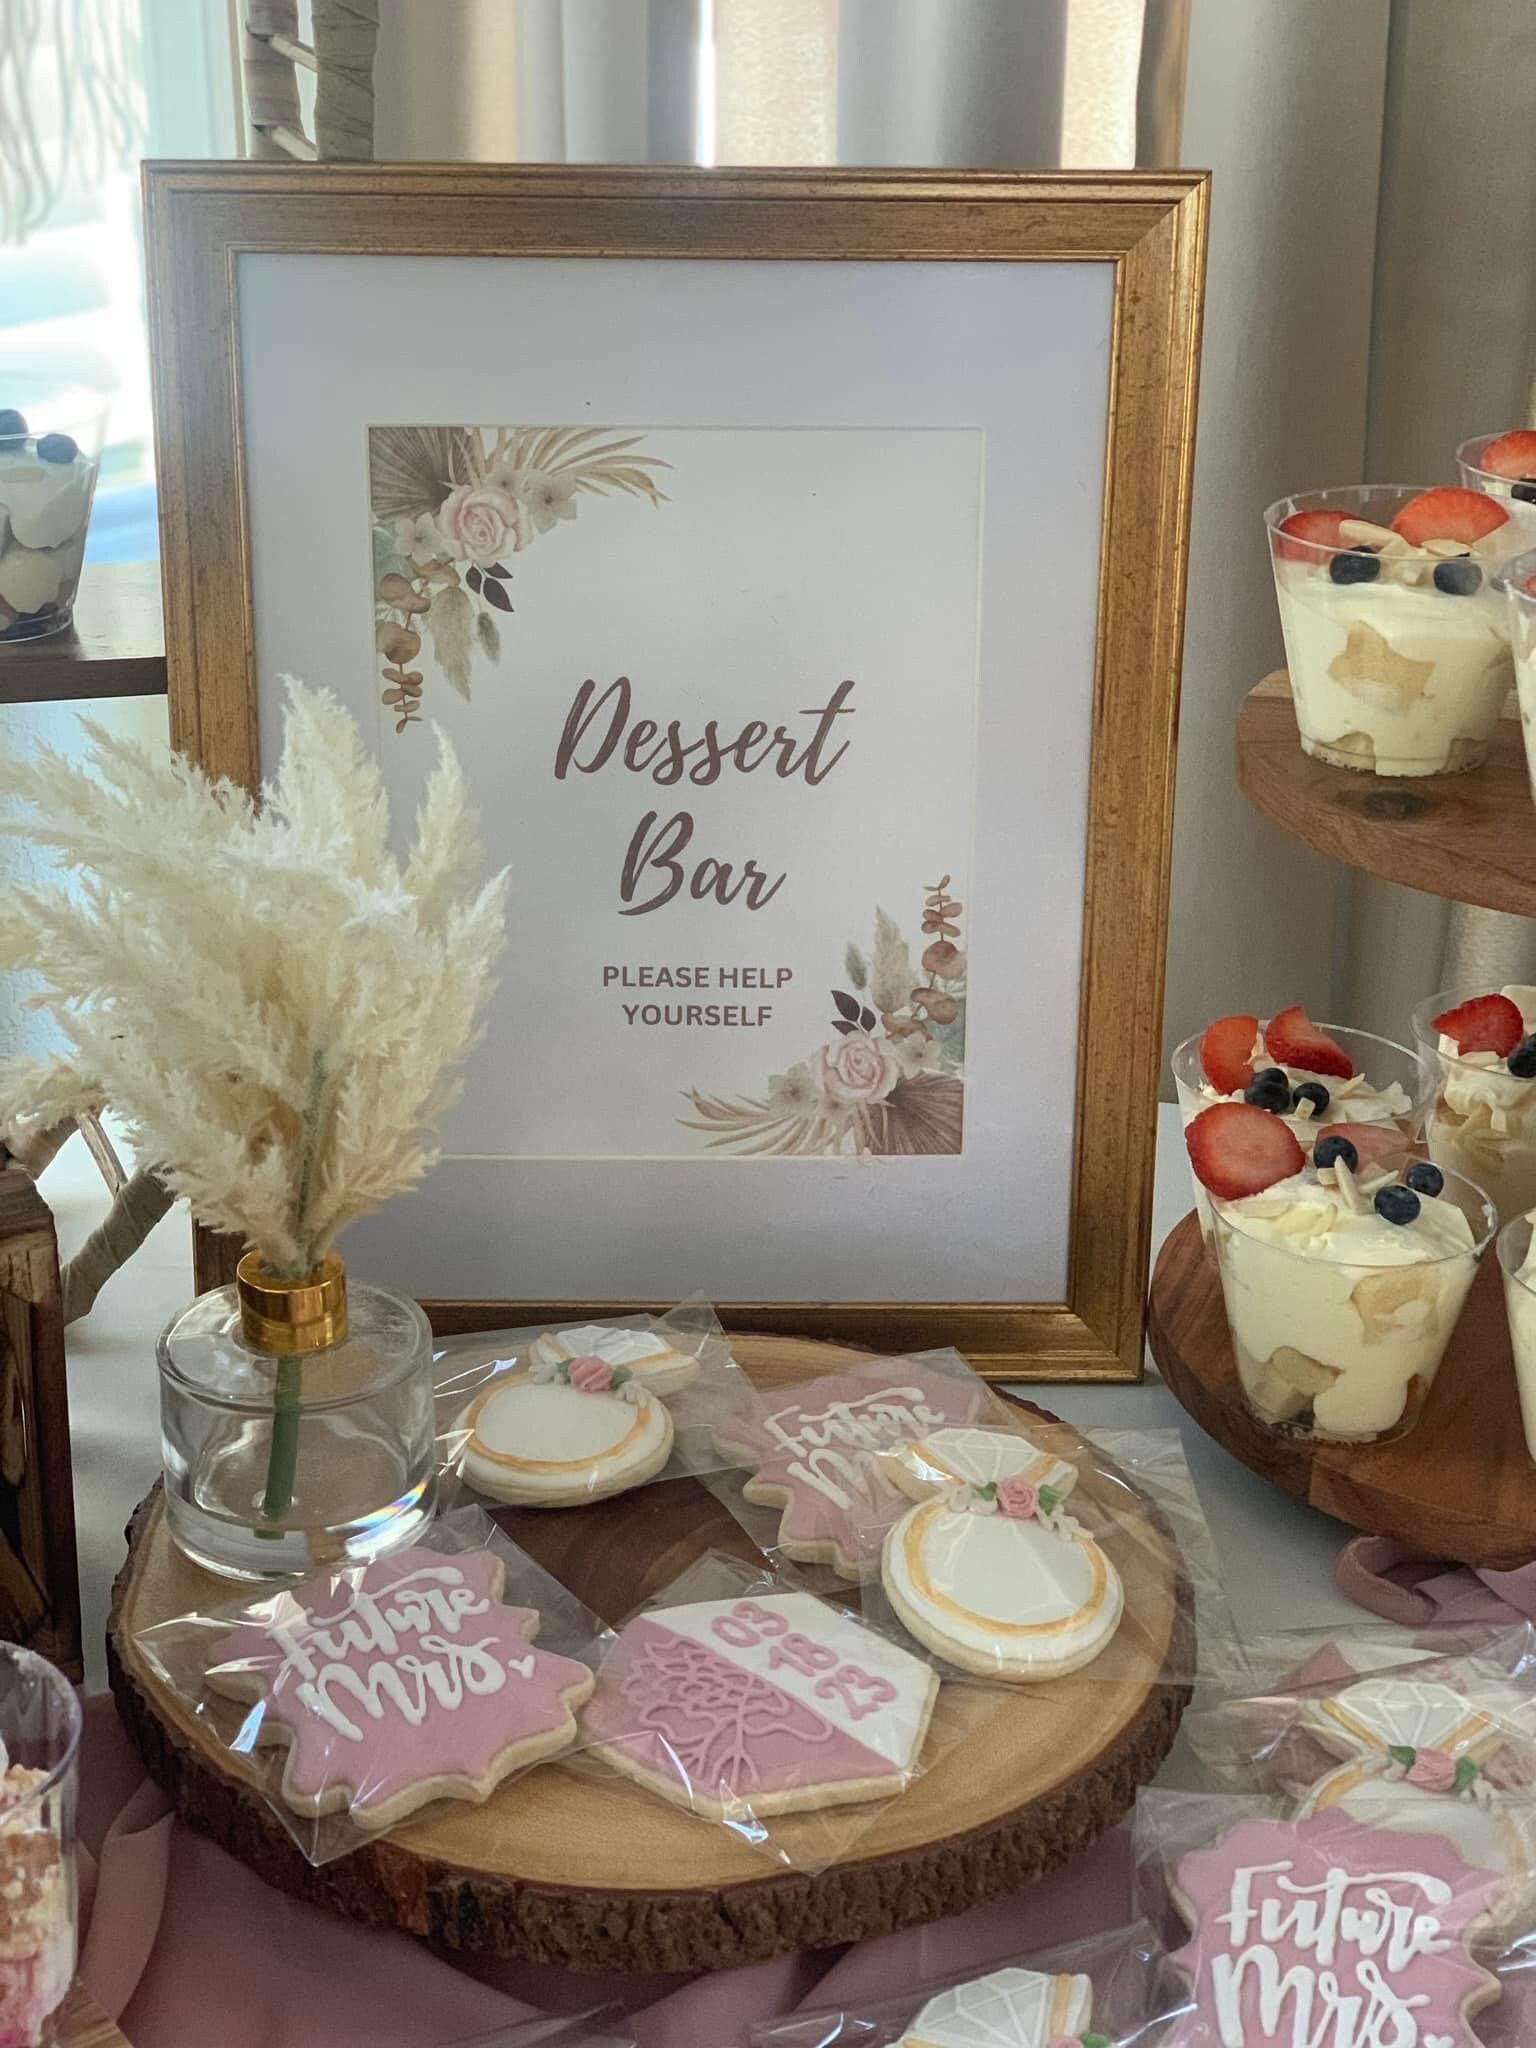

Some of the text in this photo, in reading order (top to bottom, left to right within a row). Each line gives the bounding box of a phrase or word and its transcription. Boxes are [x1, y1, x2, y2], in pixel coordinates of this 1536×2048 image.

[553, 676, 856, 786] Dessert
[617, 811, 787, 916] Bar
[602, 966, 793, 989] PLEASE HELP
[622, 1004, 772, 1027] YOURSELF
[711, 1601, 789, 1648] 03
[768, 1632, 839, 1678] 18
[815, 1664, 897, 1720] 23
